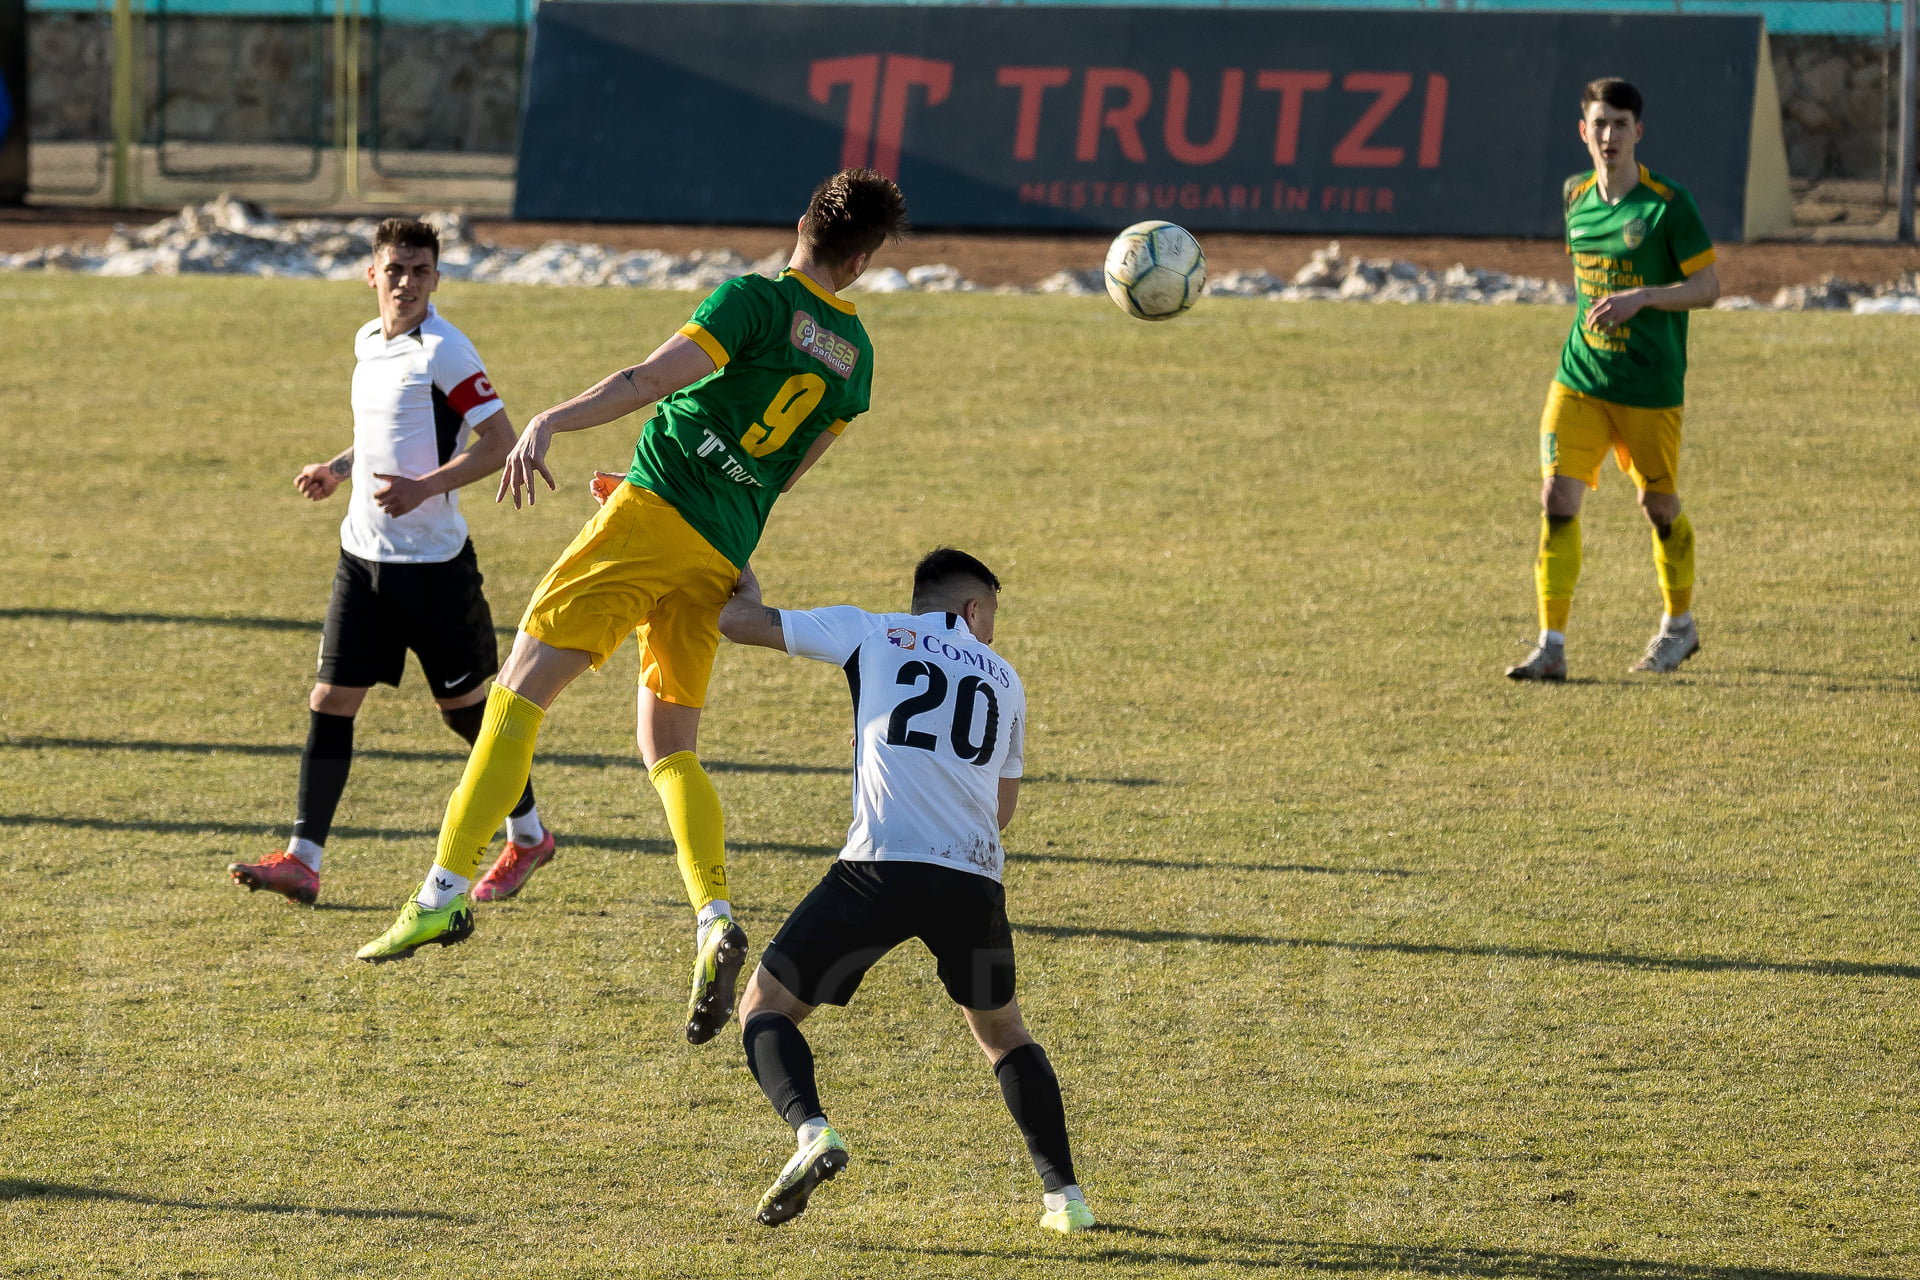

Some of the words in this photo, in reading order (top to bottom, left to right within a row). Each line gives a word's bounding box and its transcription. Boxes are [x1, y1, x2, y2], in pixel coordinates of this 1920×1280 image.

[998, 66, 1448, 168] TRUTZI
[1273, 180, 1309, 211] ÎN
[1322, 186, 1394, 213] FIER
[1611, 272, 1645, 287] LOCAL
[815, 332, 855, 366] casa
[473, 376, 495, 397] C
[739, 372, 827, 458] 9
[720, 454, 766, 488] TRUT
[922, 634, 1010, 689] COMES
[886, 659, 1000, 767] 20
